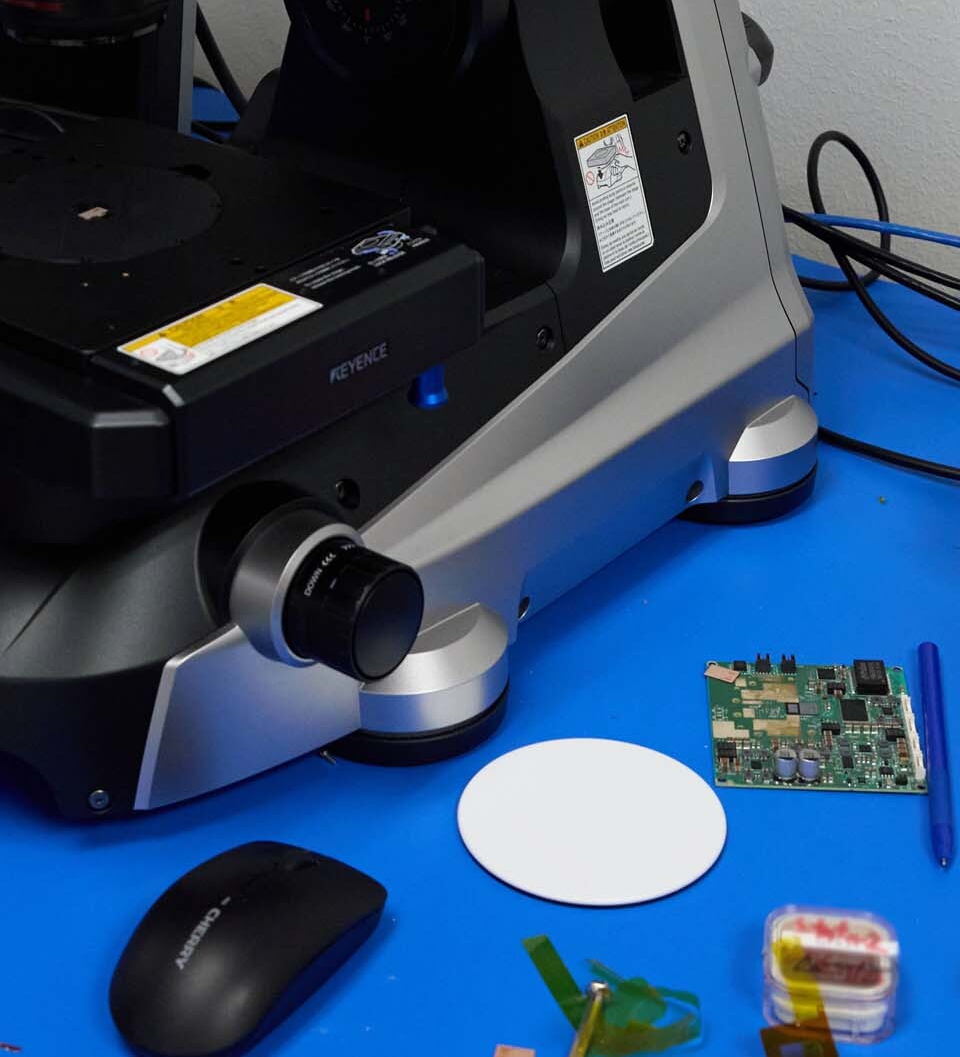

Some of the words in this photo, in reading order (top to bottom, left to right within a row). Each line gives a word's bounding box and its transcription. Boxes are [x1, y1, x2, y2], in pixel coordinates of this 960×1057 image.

[330, 342, 388, 383] KEYENCE
[304, 568, 323, 597] DOWN
[175, 908, 221, 970] CHERRY
